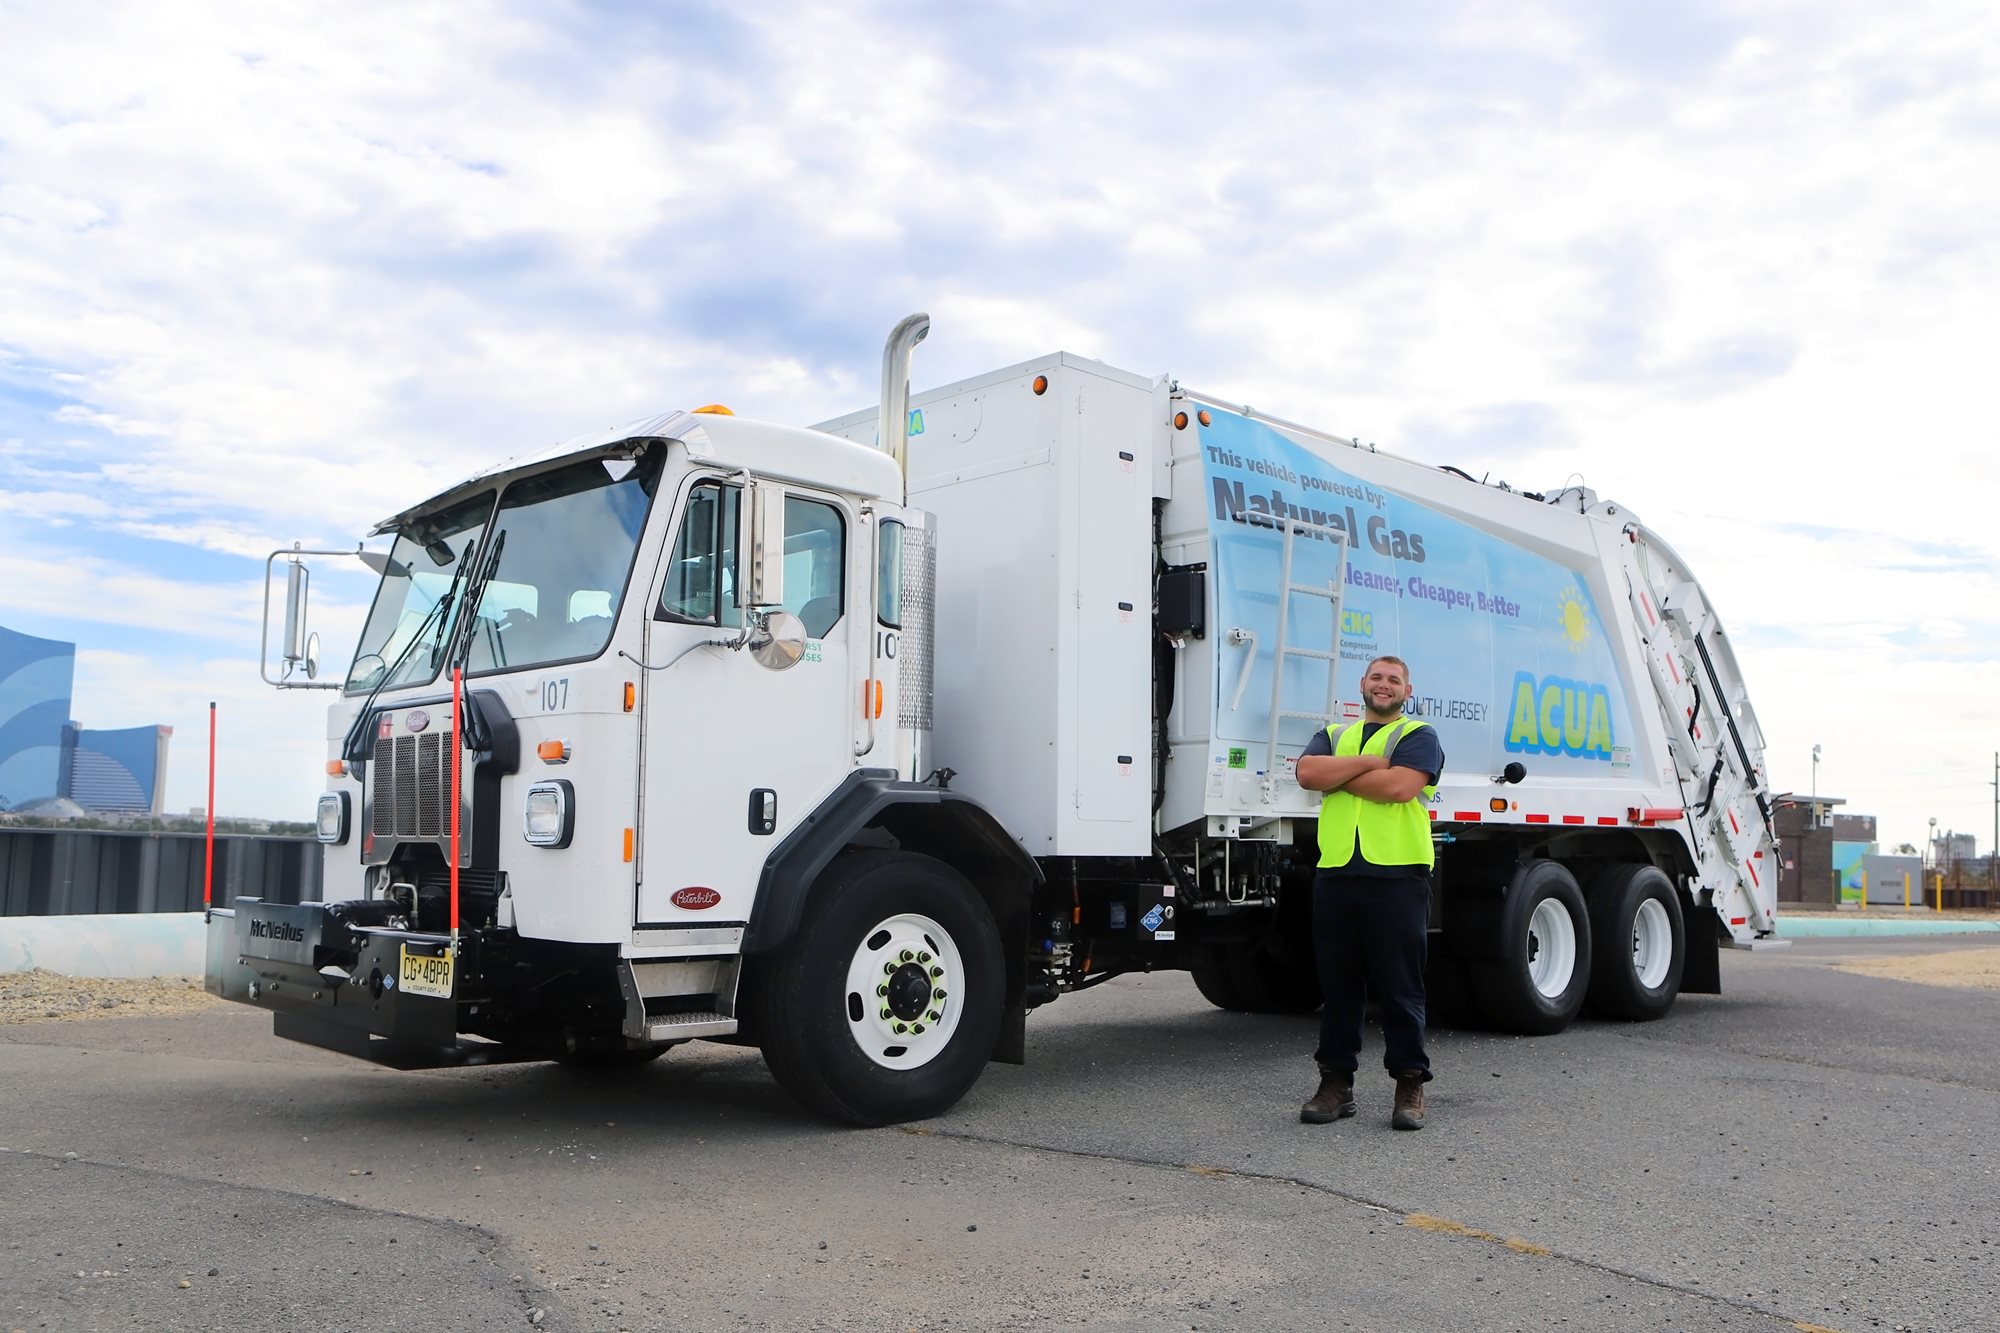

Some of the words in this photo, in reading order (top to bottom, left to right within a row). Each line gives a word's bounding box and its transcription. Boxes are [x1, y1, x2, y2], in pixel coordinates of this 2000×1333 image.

[1207, 445, 1242, 468] This
[1246, 457, 1297, 484] vehicle
[1300, 474, 1363, 500] powered
[1365, 487, 1386, 510] by:
[1212, 476, 1359, 549] Natural
[1367, 515, 1425, 563] Gas
[1337, 562, 1403, 598] leaner,
[1408, 577, 1475, 612] Cheaper,
[1477, 591, 1520, 617] Better
[1341, 609, 1373, 637] CNG
[877, 631, 899, 659] 10
[1339, 639, 1378, 651] Compressed
[1339, 650, 1364, 661] Natural
[542, 678, 568, 711] 107
[1445, 701, 1488, 721] JERSEY
[1508, 678, 1613, 755] ACUA
[676, 890, 717, 905] Peterbilt
[250, 919, 304, 942] McNeilus
